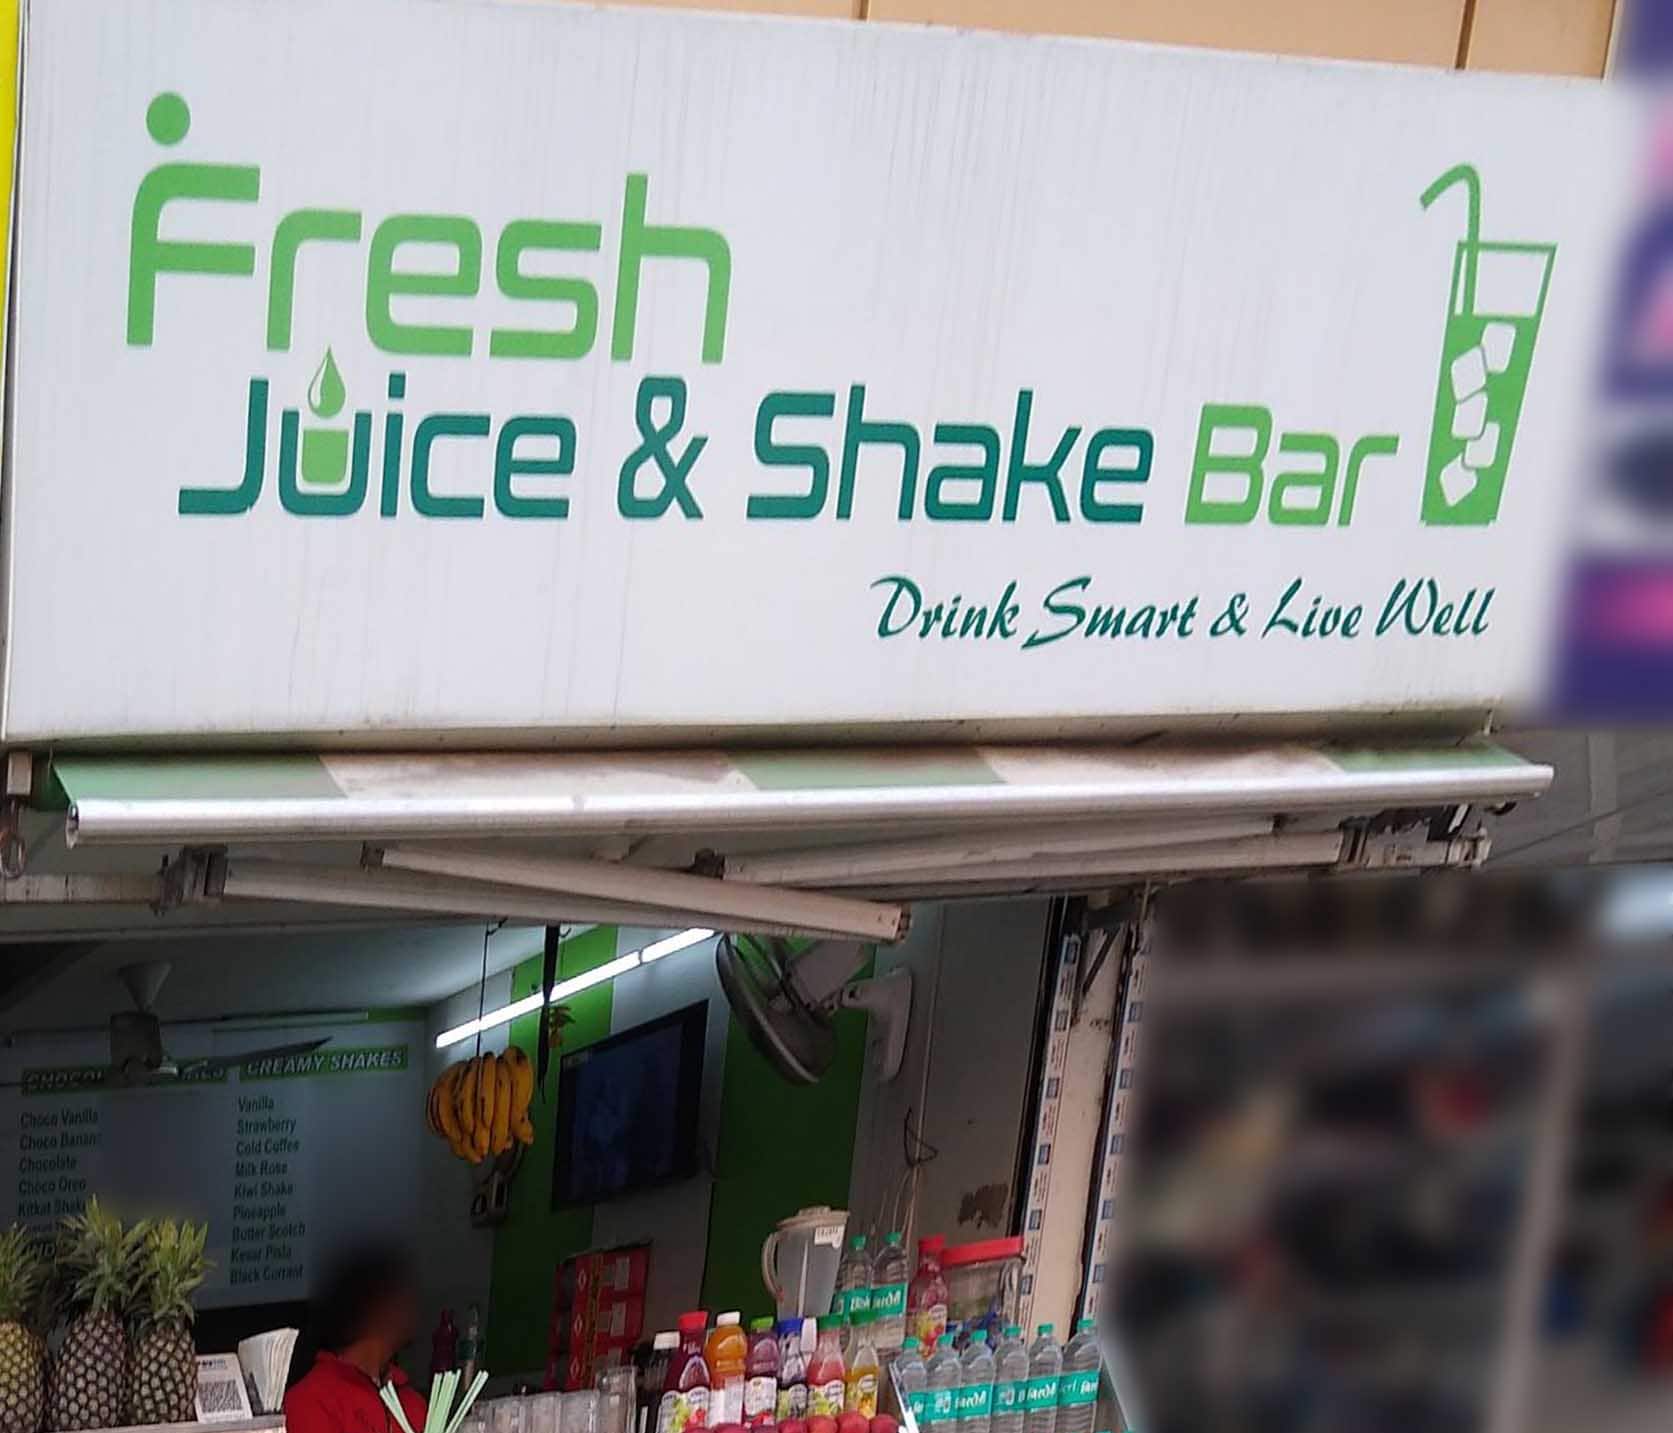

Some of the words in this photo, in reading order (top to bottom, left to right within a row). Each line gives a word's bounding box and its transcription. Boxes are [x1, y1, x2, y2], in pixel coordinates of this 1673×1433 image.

[127, 93, 731, 361] Fresh
[177, 371, 577, 521] Juice
[617, 375, 708, 521] &
[745, 384, 1154, 525] Shake
[1187, 405, 1400, 527] Bar
[870, 576, 1020, 639] Drink
[1021, 576, 1199, 651] Smart
[1209, 594, 1248, 638] &
[1262, 577, 1360, 638] Live
[1374, 578, 1496, 637] Well
[331, 1050, 402, 1073] SHAKES
